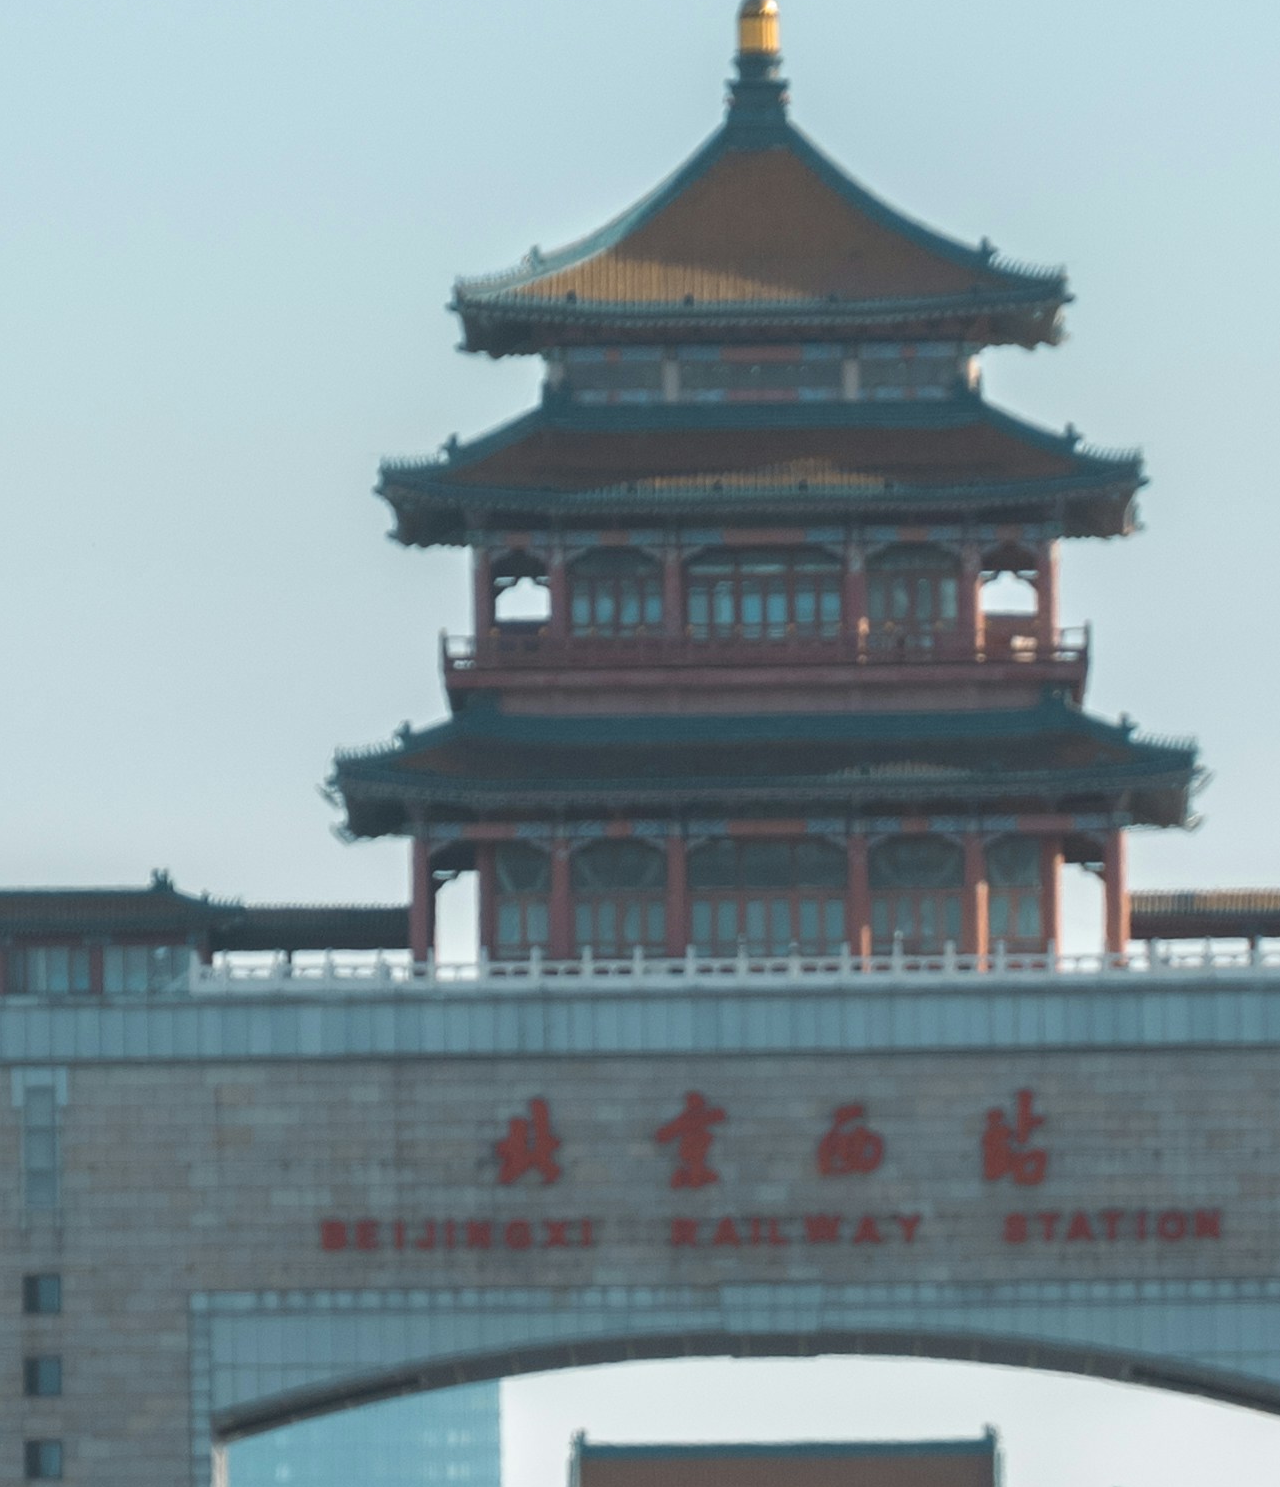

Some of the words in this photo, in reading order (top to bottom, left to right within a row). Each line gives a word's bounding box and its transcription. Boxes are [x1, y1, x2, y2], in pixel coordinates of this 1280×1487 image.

[495, 1089, 1049, 1189] 北京西站
[321, 1216, 596, 1254] BEIJINGXI
[670, 1211, 924, 1248] RAILWAY
[1002, 1207, 1224, 1244] STATION
